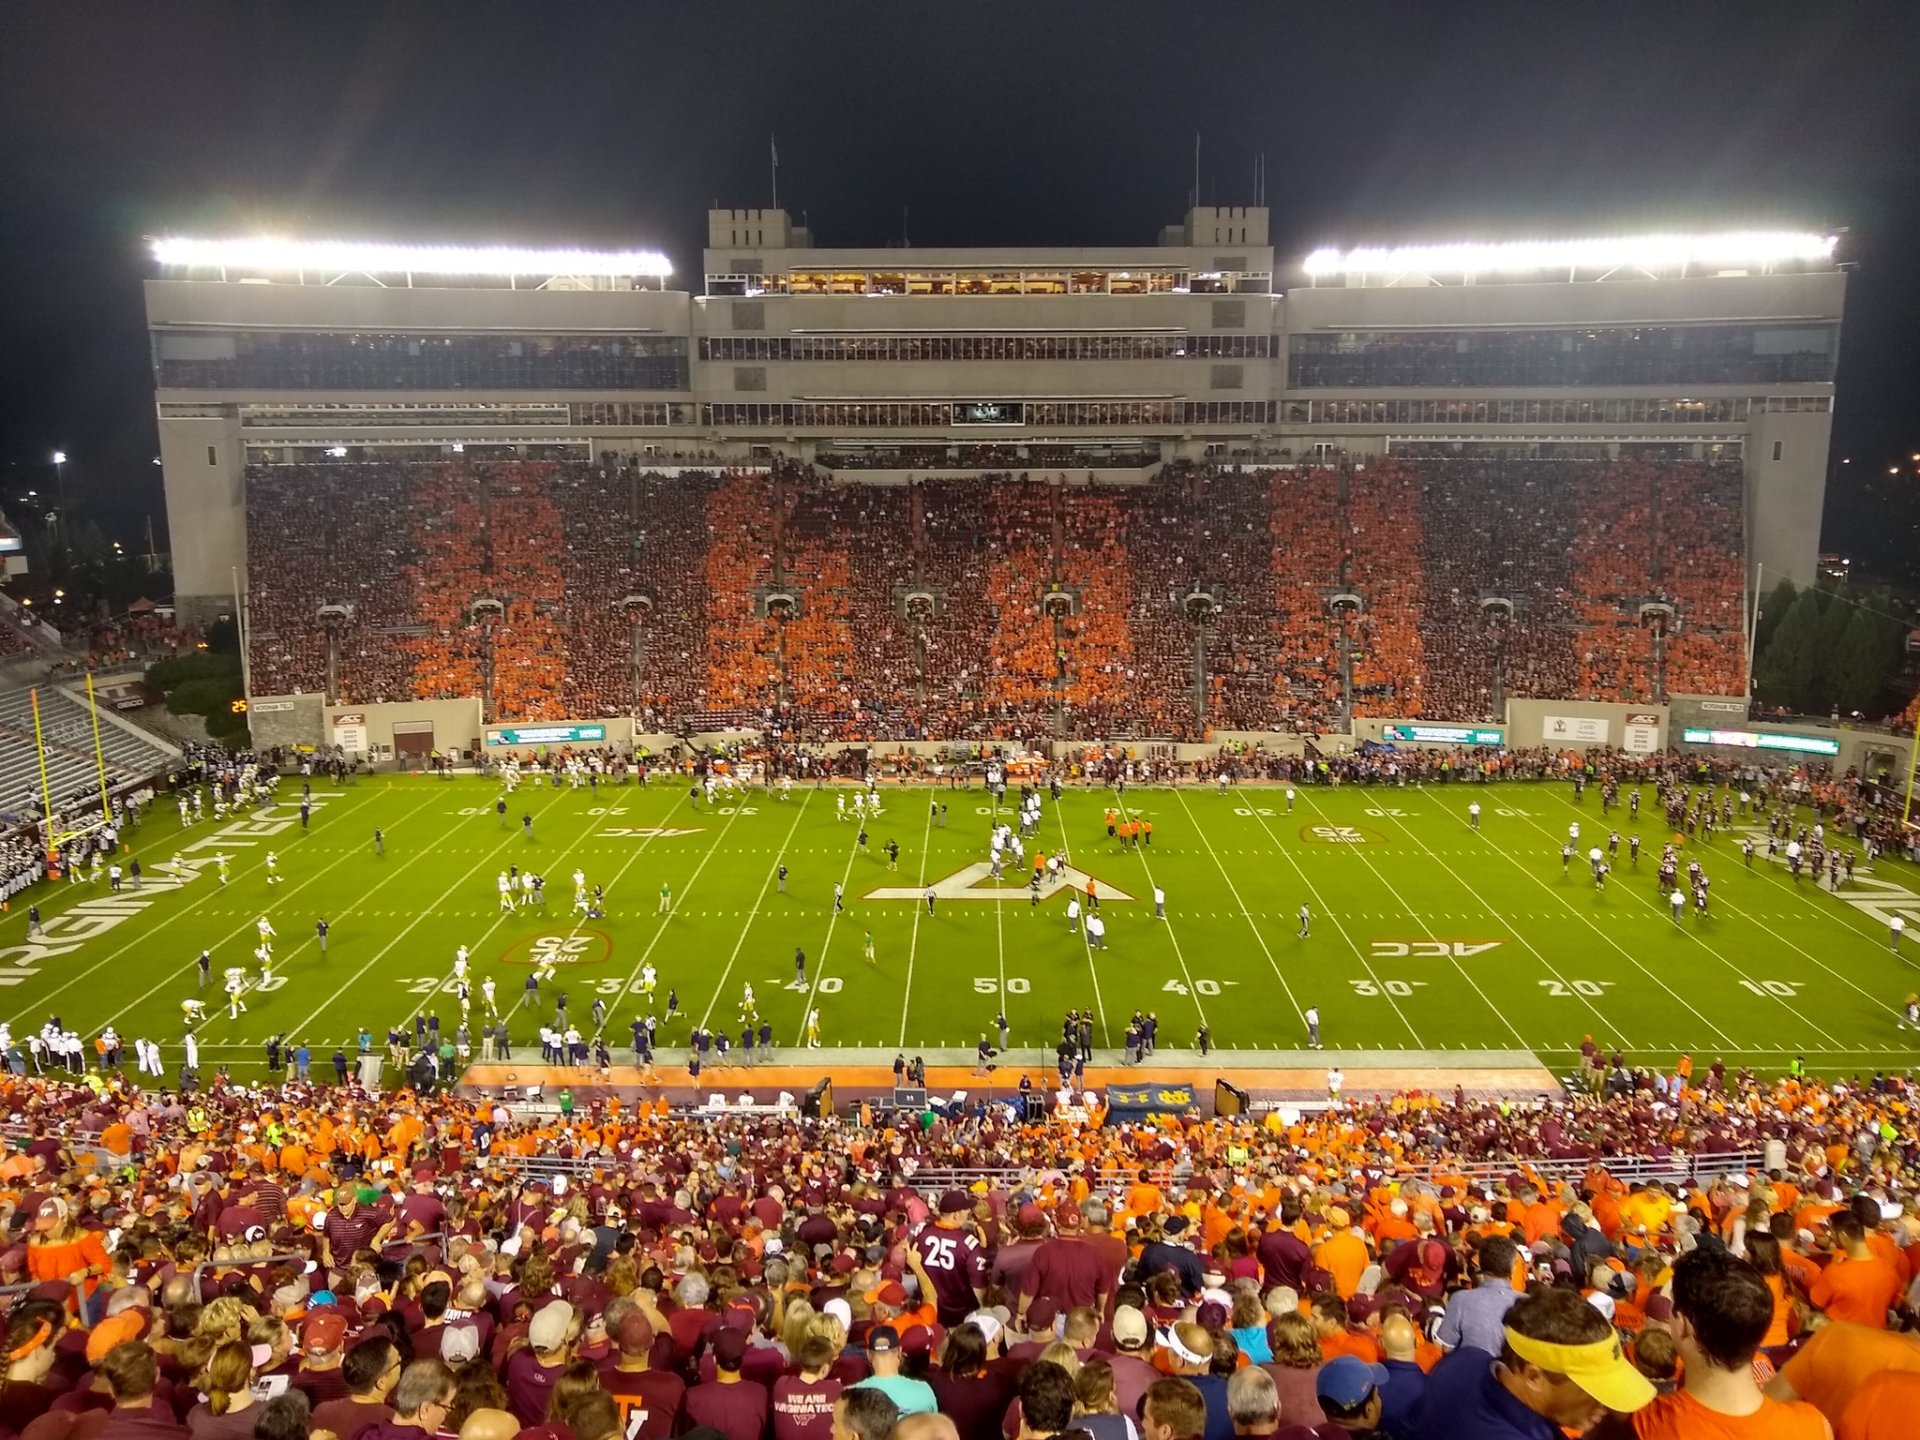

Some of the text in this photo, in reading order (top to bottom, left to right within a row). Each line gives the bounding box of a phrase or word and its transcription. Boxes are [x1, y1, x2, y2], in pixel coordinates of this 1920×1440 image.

[232, 700, 247, 713] 25
[587, 807, 630, 816] 20
[718, 807, 759, 816] 30
[975, 807, 1015, 815] 50
[1233, 808, 1277, 816] 30
[1364, 808, 1408, 817] 20
[596, 978, 656, 994] 30
[973, 978, 1031, 994] 50
[1162, 978, 1223, 996] 40
[1349, 980, 1413, 996] 30
[1538, 980, 1605, 996] 20
[1739, 980, 1798, 996] 10
[924, 1235, 958, 1271] 25
[788, 1394, 827, 1404] WE ARE
[774, 1402, 835, 1413] VIRGINIA TEC
